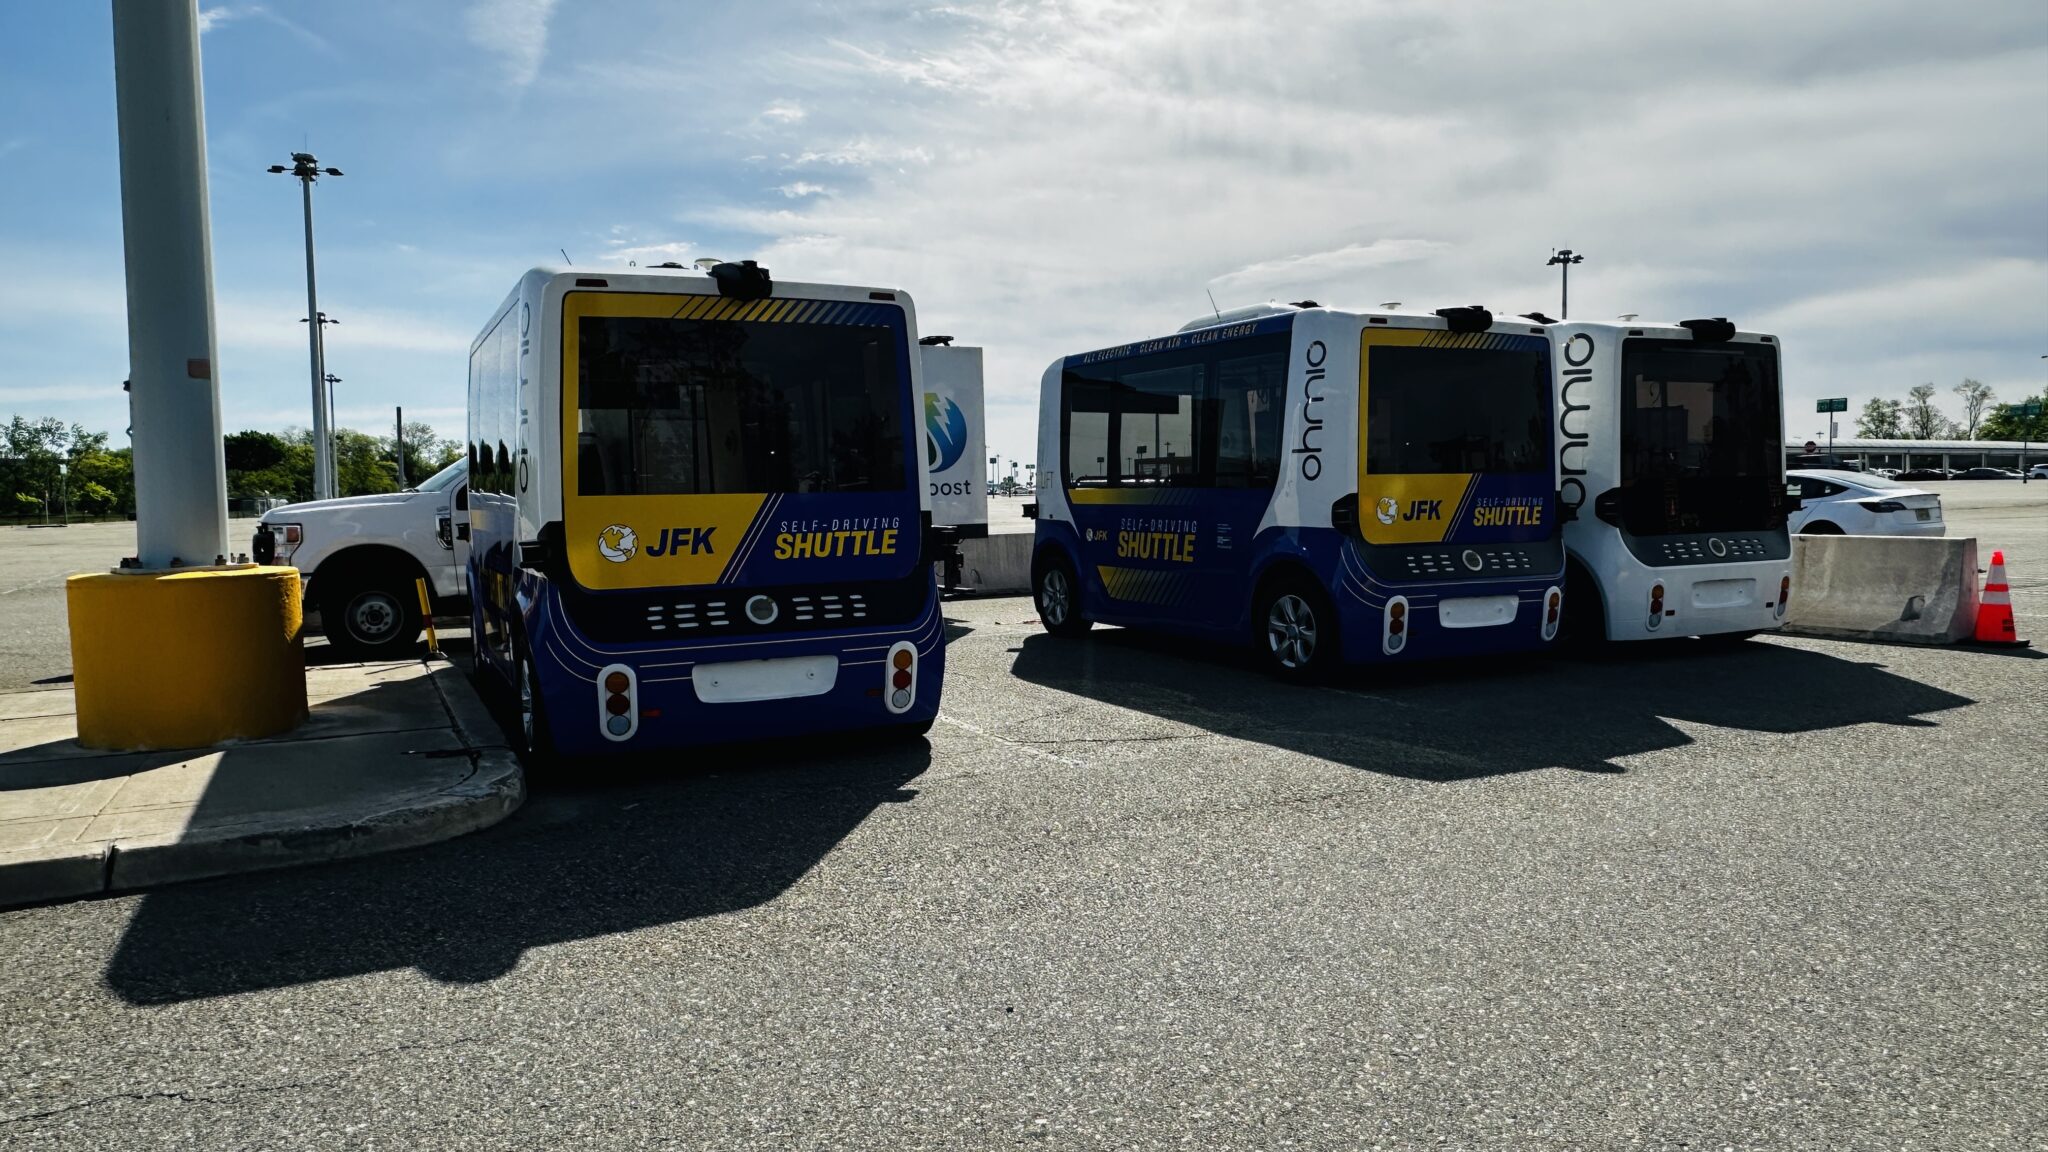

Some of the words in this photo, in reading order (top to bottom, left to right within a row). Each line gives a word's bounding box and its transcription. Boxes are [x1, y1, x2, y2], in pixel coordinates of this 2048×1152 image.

[1082, 354, 1095, 364] ALL
[1098, 345, 1131, 361] ELECTRIC
[1139, 341, 1163, 354] CLEAN
[1165, 337, 1182, 350] AIR
[1191, 331, 1218, 345] CLEAN
[1221, 323, 1258, 339] ENERGY
[1292, 339, 1327, 481] ohmio
[1402, 499, 1443, 522] JFK
[1475, 496, 1545, 508] SELF-DRIVING
[780, 516, 901, 534] SELF-DRIVING
[1120, 517, 1199, 534] SELF-DRIVING
[1473, 505, 1543, 527] SHUTTLE
[646, 526, 719, 558] JFK
[774, 528, 899, 561] SHUTTLE
[1093, 529, 1109, 542] JFK
[1116, 530, 1197, 563] SHUTTLE
